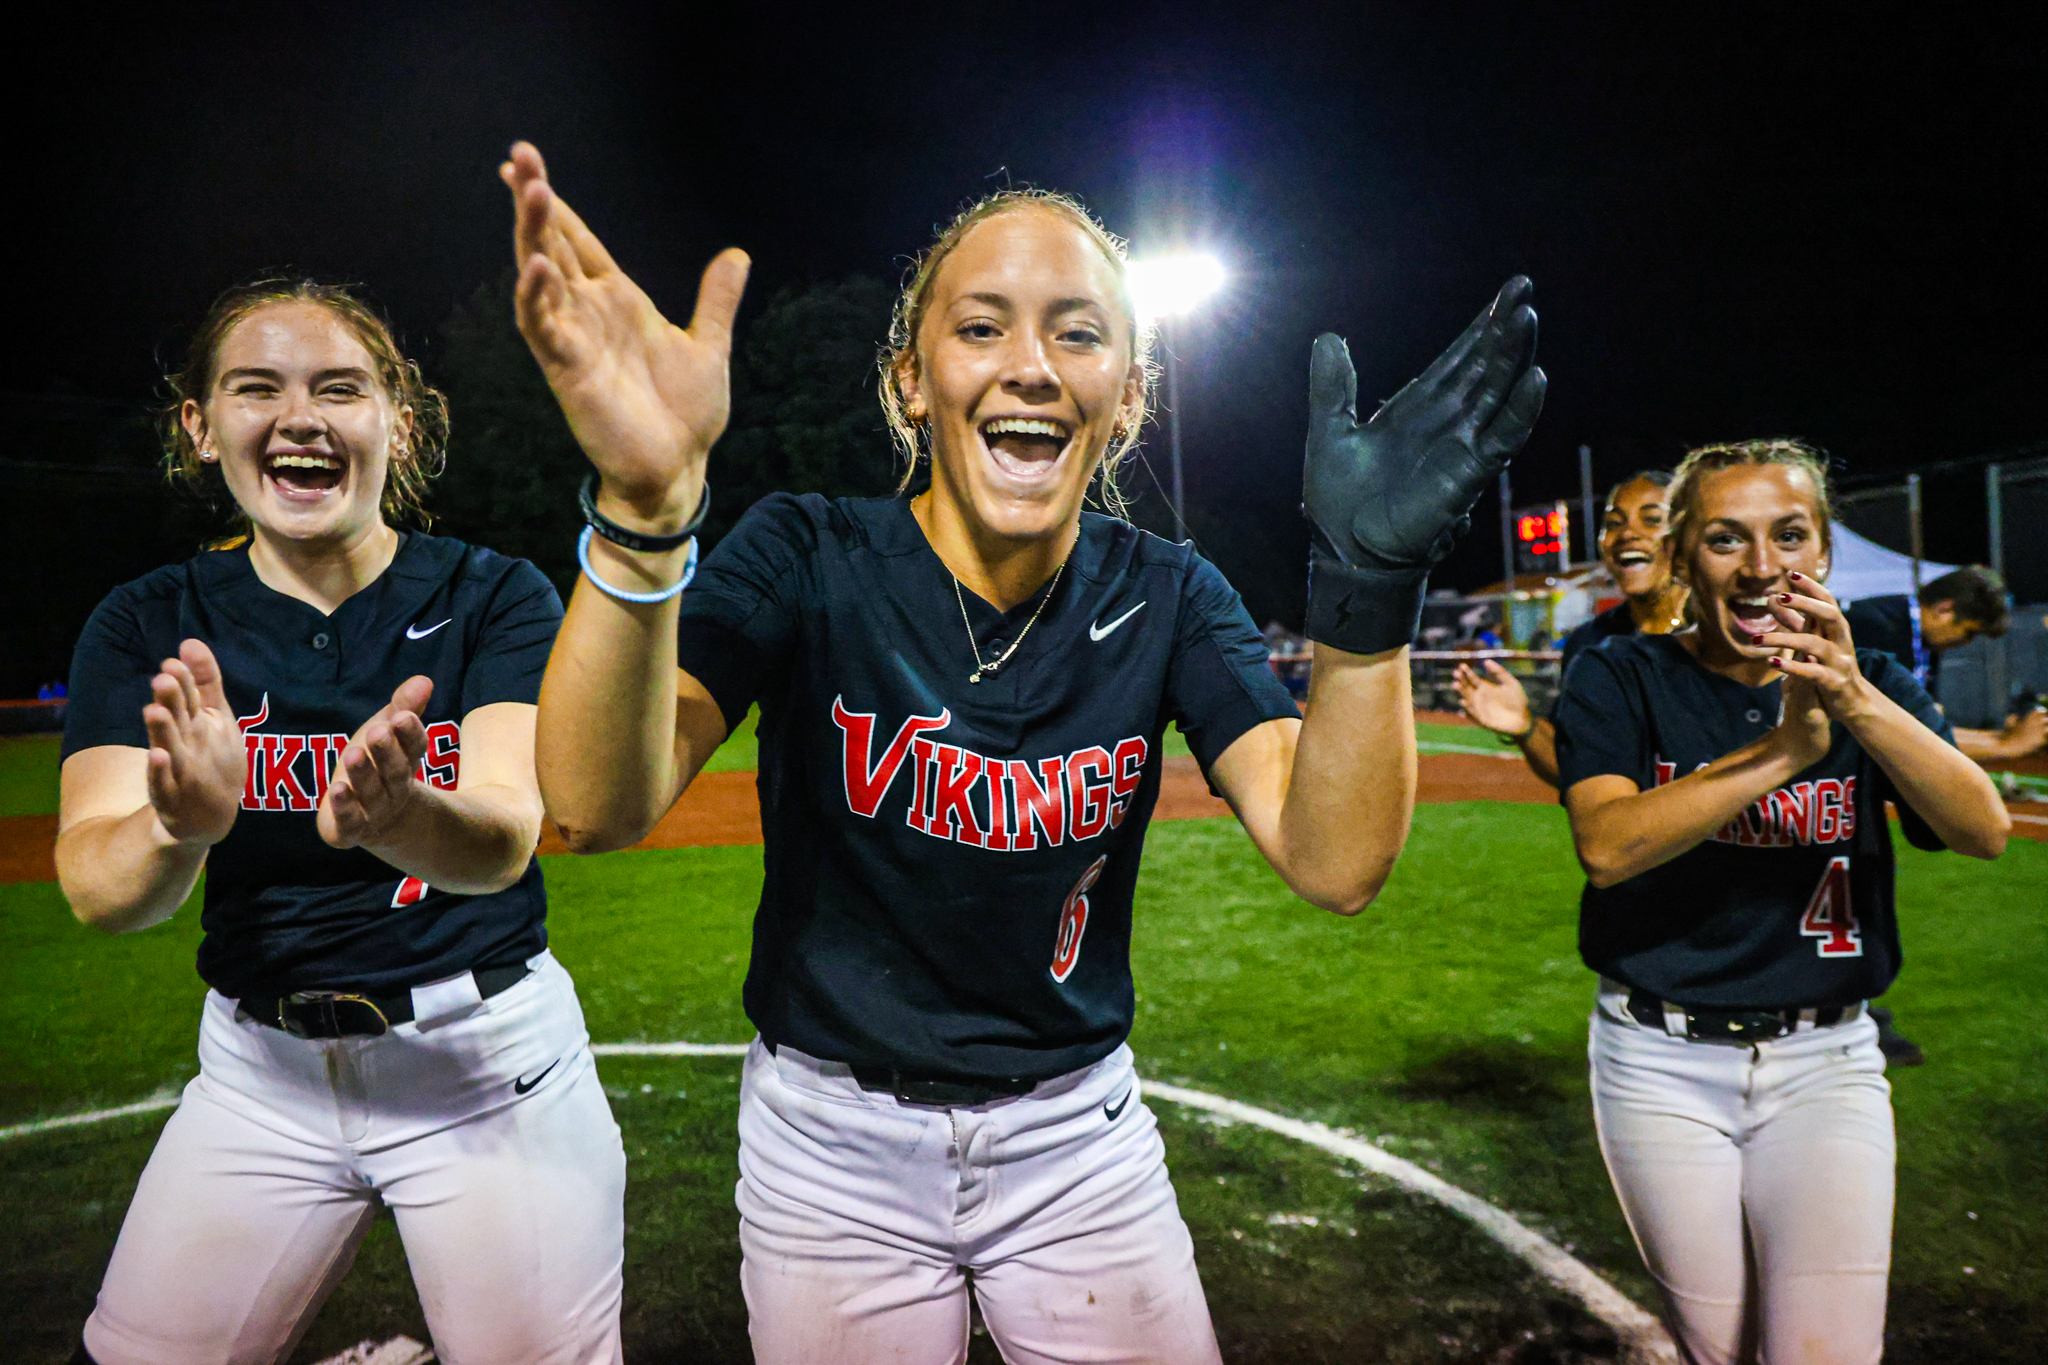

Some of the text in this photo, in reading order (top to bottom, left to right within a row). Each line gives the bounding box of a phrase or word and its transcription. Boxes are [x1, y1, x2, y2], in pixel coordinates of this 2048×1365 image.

[236, 692, 461, 811] IKIS
[832, 694, 1148, 851] VIKINGS
[1655, 753, 1857, 847] INGS
[1050, 854, 1107, 983] 6
[1800, 856, 1863, 958] 4
